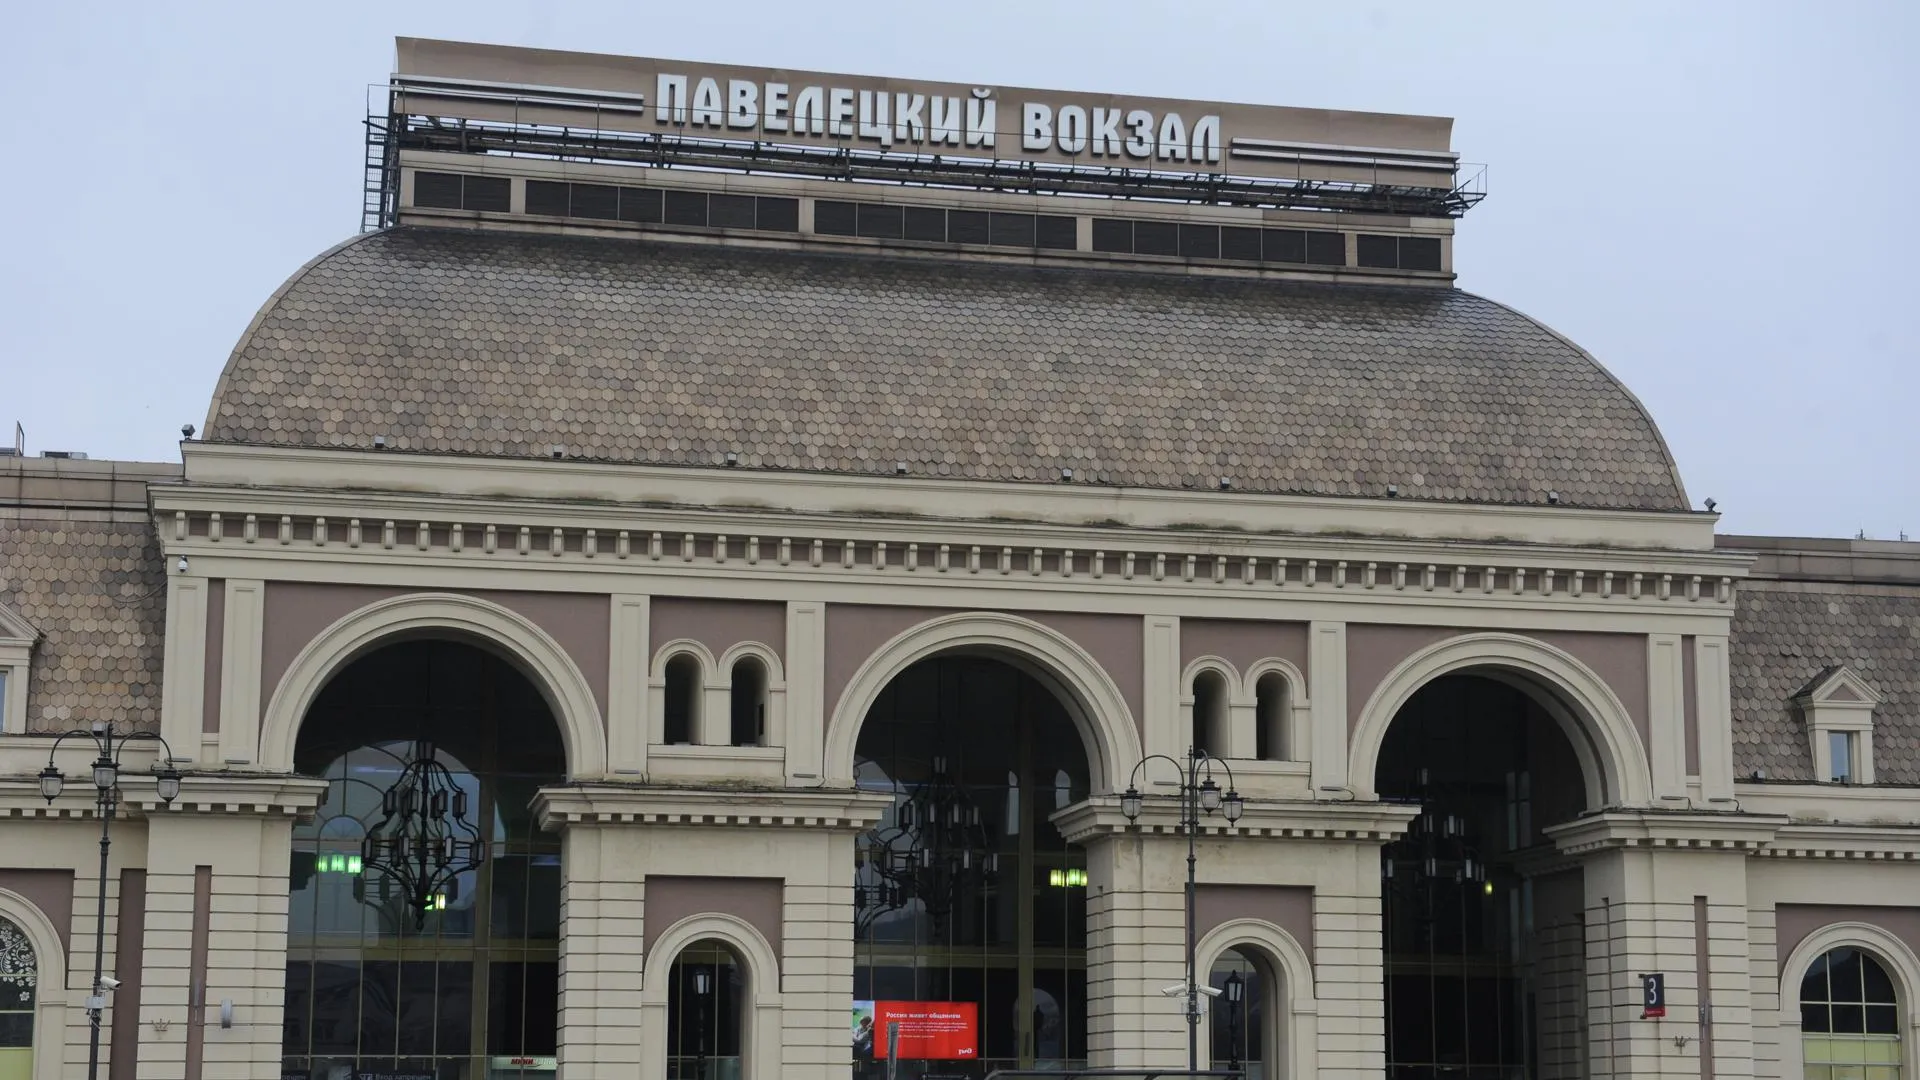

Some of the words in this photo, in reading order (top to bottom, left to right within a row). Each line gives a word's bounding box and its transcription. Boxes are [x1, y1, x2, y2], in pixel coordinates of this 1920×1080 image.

[656, 73, 997, 147] ПАВЕЛЕЦКИЙ
[1022, 102, 1220, 163] ВОКЗАЛ
[1649, 978, 1657, 1004] 3
